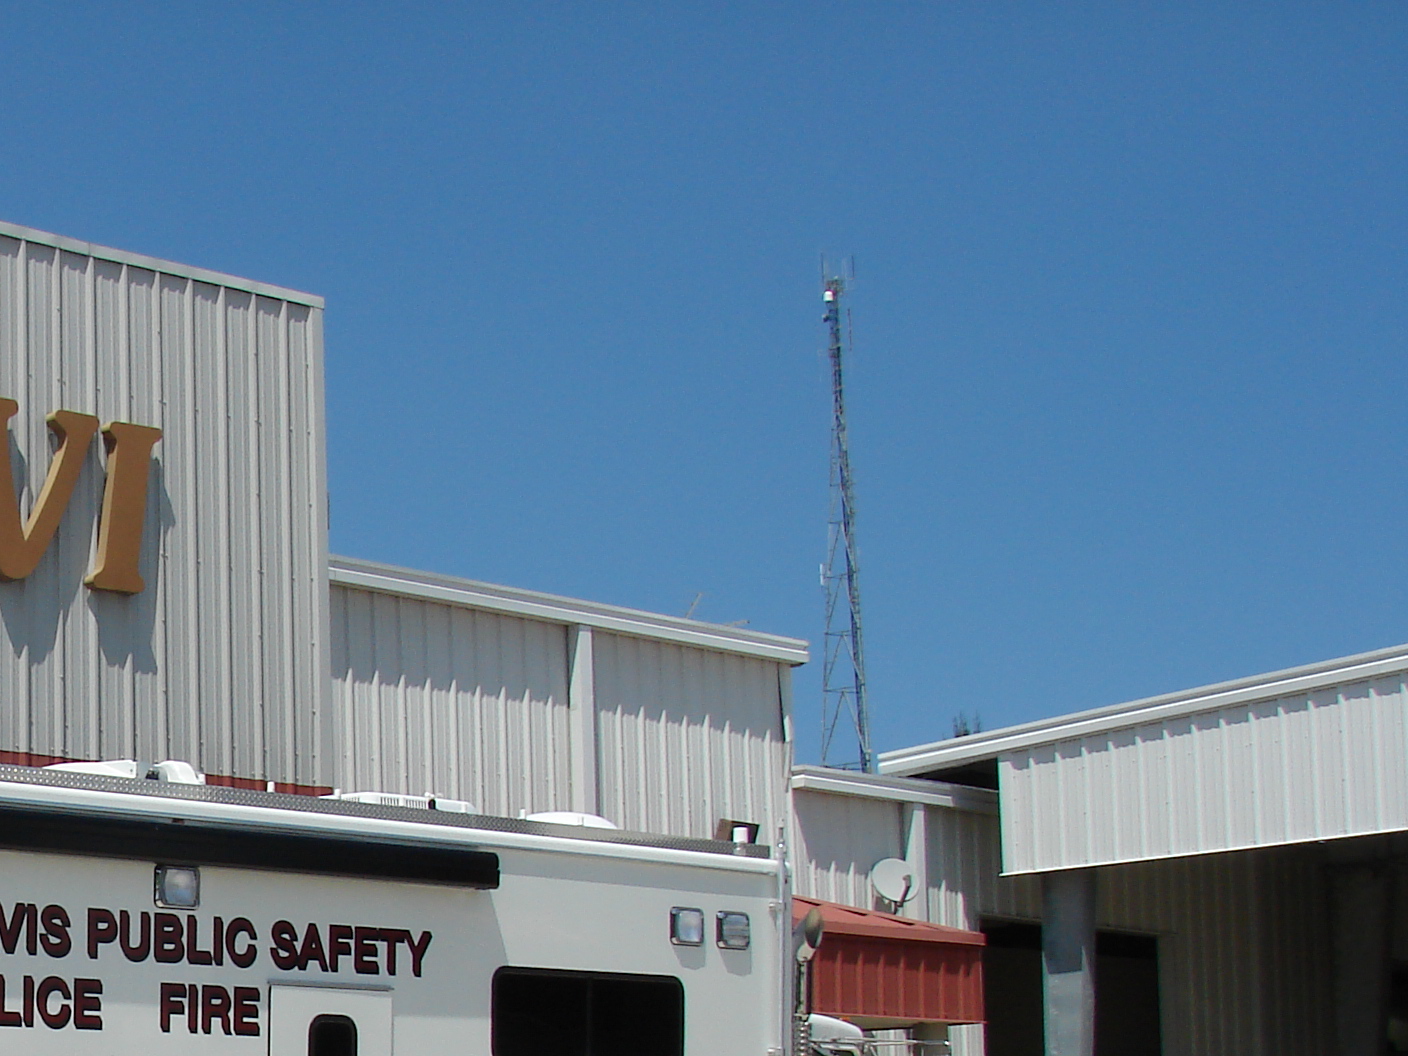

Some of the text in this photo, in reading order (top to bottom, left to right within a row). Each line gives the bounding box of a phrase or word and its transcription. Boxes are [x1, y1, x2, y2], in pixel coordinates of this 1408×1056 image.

[86, 907, 258, 968] PUBLIC
[269, 919, 433, 978] SAFETY
[159, 981, 261, 1036] FIRE
